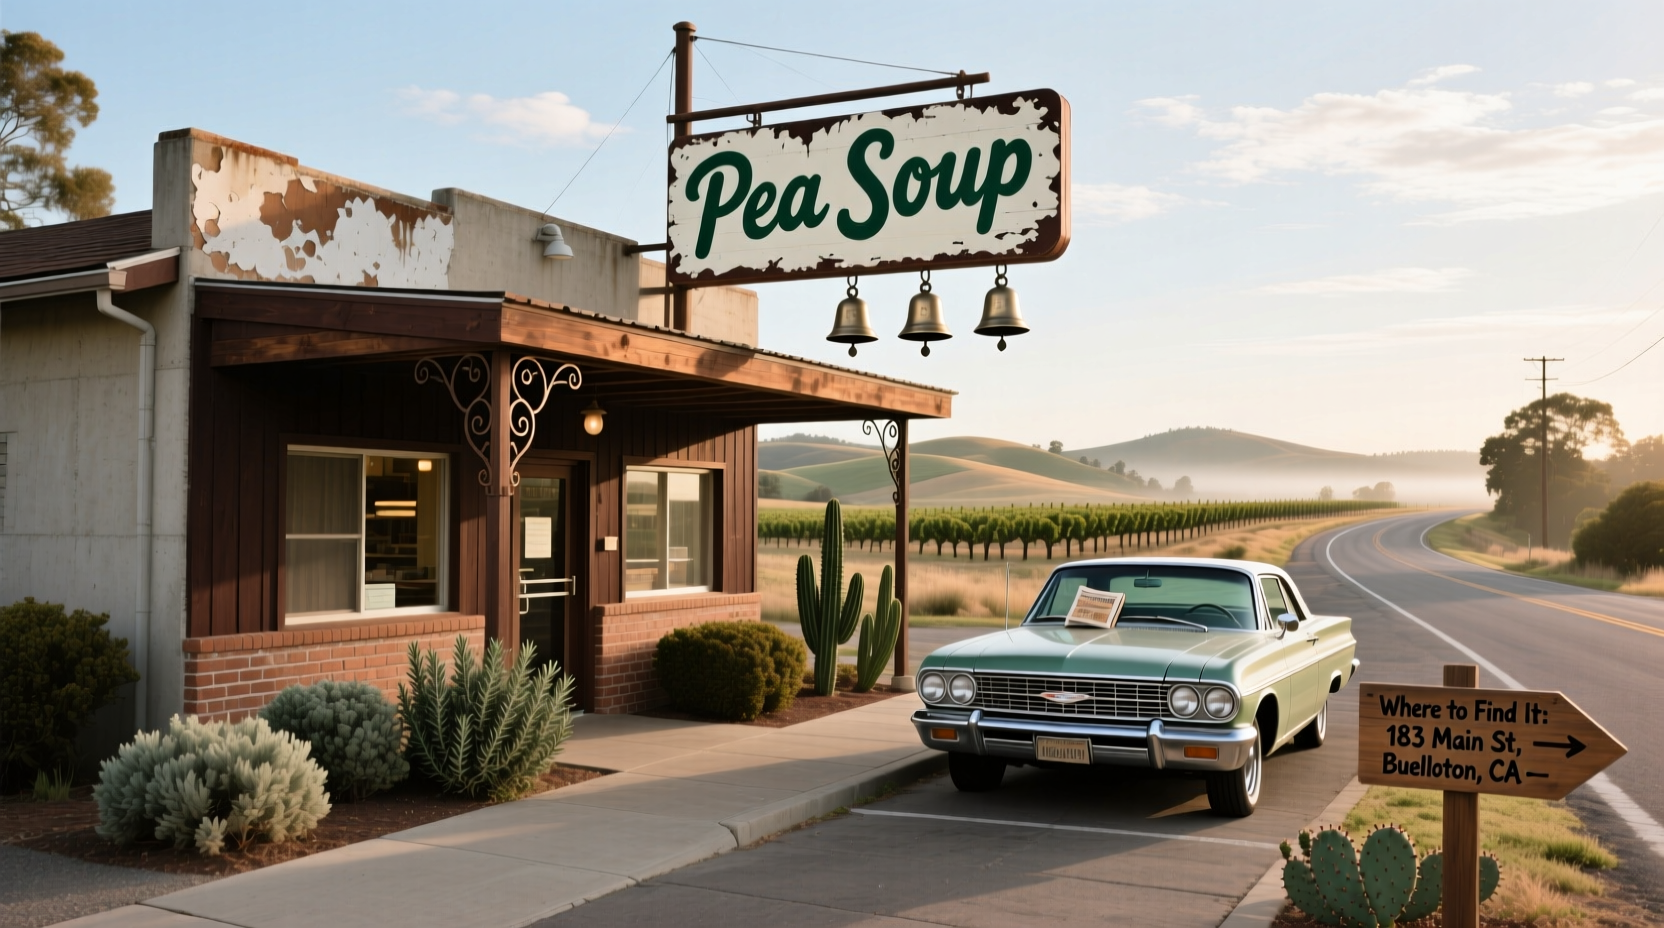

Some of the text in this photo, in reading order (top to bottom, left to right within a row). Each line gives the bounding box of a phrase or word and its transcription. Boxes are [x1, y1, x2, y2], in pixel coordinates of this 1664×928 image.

[685, 127, 1033, 259] Pea Soup
[1379, 694, 1549, 725] Where to Find It:
[1386, 724, 1522, 758] 183 Main St,
[1382, 751, 1483, 786] Buelloton,
